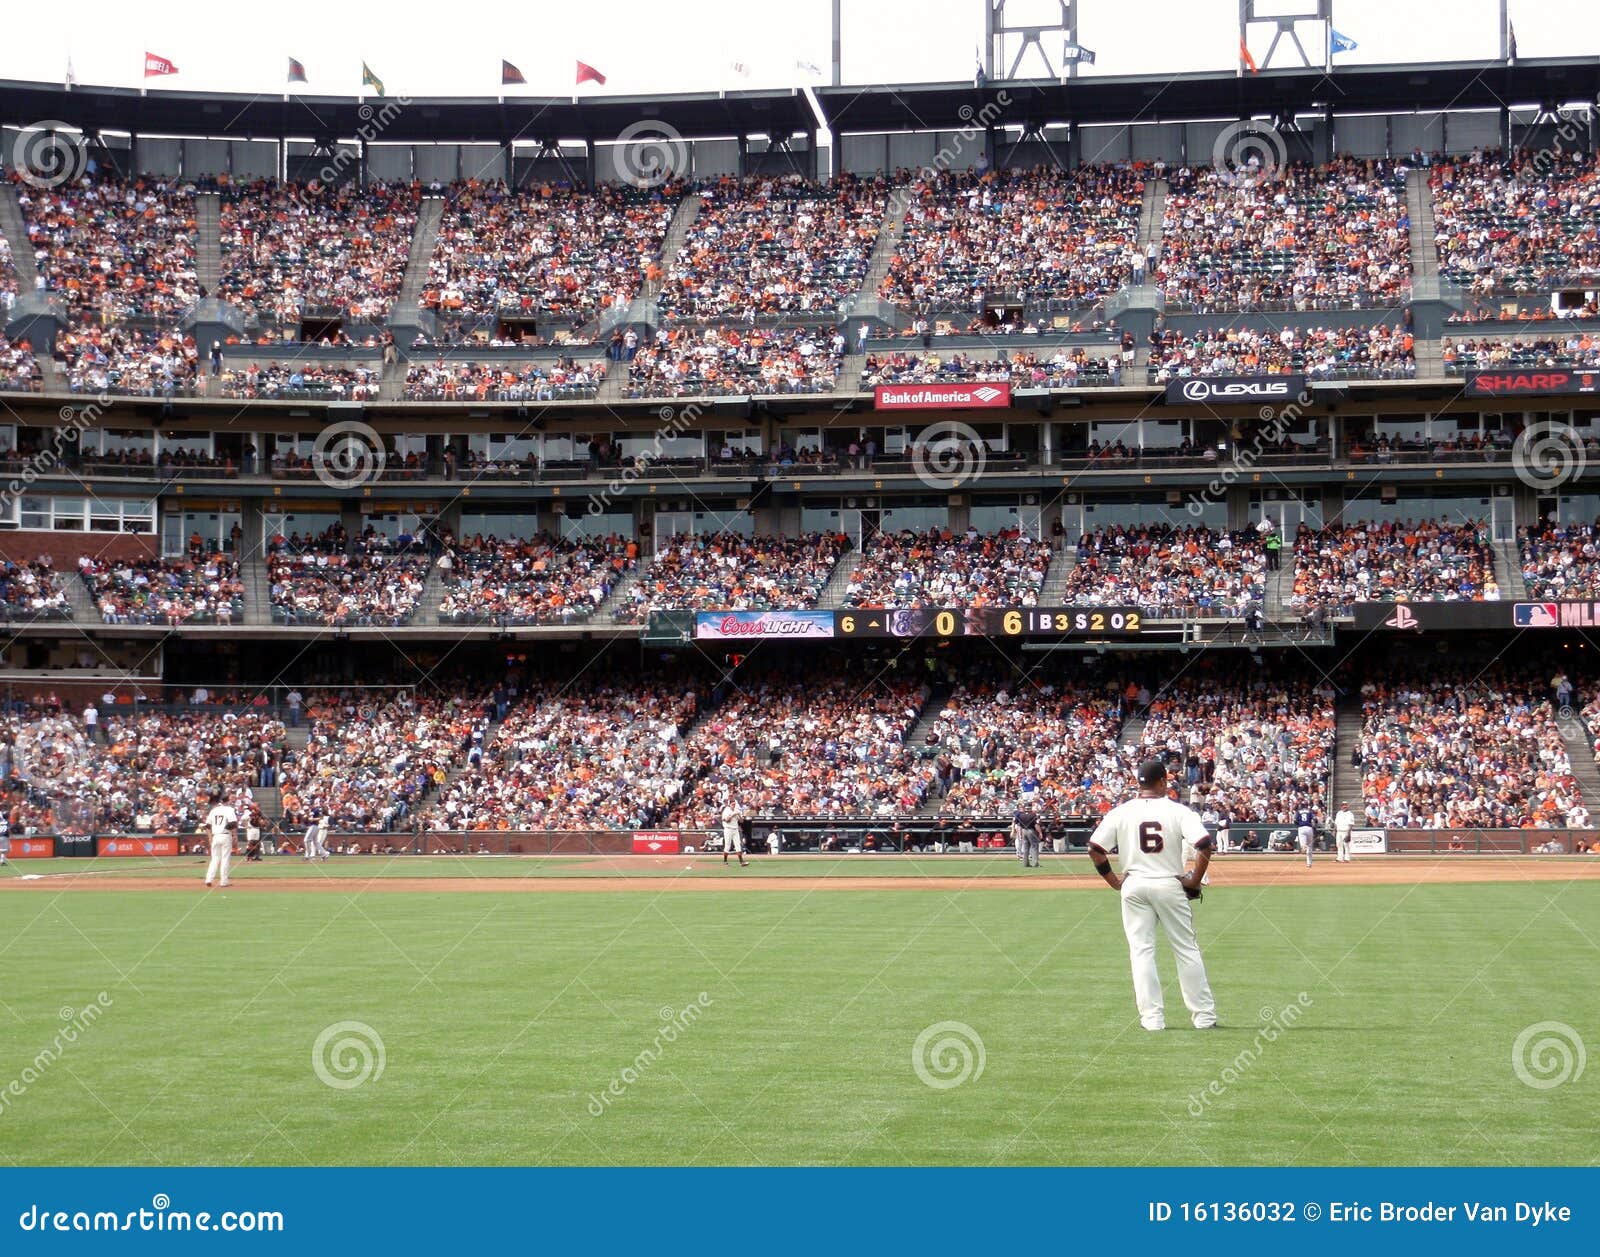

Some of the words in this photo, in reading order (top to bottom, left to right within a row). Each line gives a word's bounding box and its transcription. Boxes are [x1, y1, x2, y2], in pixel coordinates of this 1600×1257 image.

[1212, 383, 1288, 395] LEXUS
[1475, 374, 1568, 389] SHARP
[882, 392, 913, 403] Bank
[912, 392, 926, 402] of
[925, 391, 971, 402] America
[720, 616, 765, 635] Coors
[764, 621, 812, 633] LIGHT
[842, 616, 855, 632] 6
[936, 612, 955, 635] 0
[1003, 611, 1022, 634] 6
[215, 815, 224, 825] 17
[1139, 821, 1164, 854] 6
